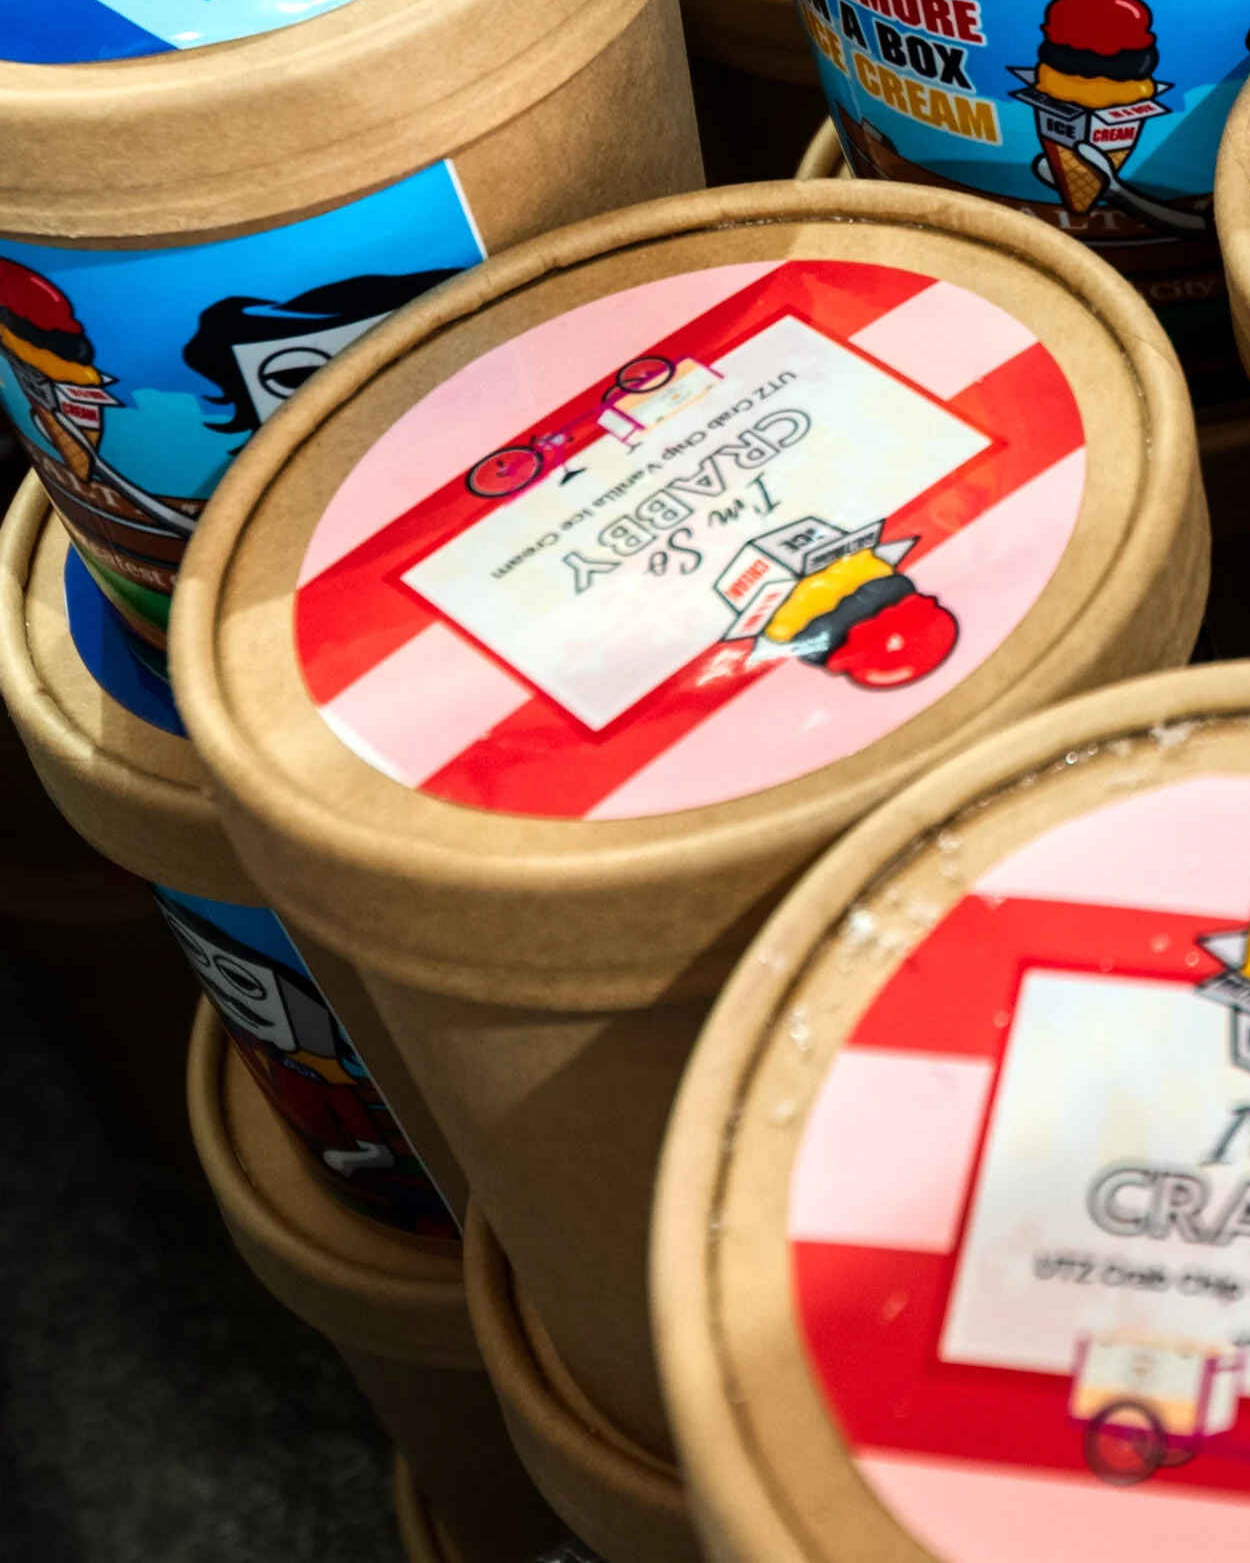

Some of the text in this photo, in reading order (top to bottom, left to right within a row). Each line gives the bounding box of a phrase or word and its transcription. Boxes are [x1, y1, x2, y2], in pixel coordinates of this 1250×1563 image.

[804, 7, 999, 143] ICE CREAM
[839, 0, 868, 50] A
[875, 20, 973, 91] BOX
[1046, 118, 1136, 143] ICE CREAM
[1150, 278, 1215, 300] City
[491, 370, 797, 579] UTZ Crab Chip Vanilla Ice Cream
[562, 408, 812, 596] CRABBY
[643, 470, 782, 577] I'm So
[1034, 1252, 1098, 1285] UTZ
